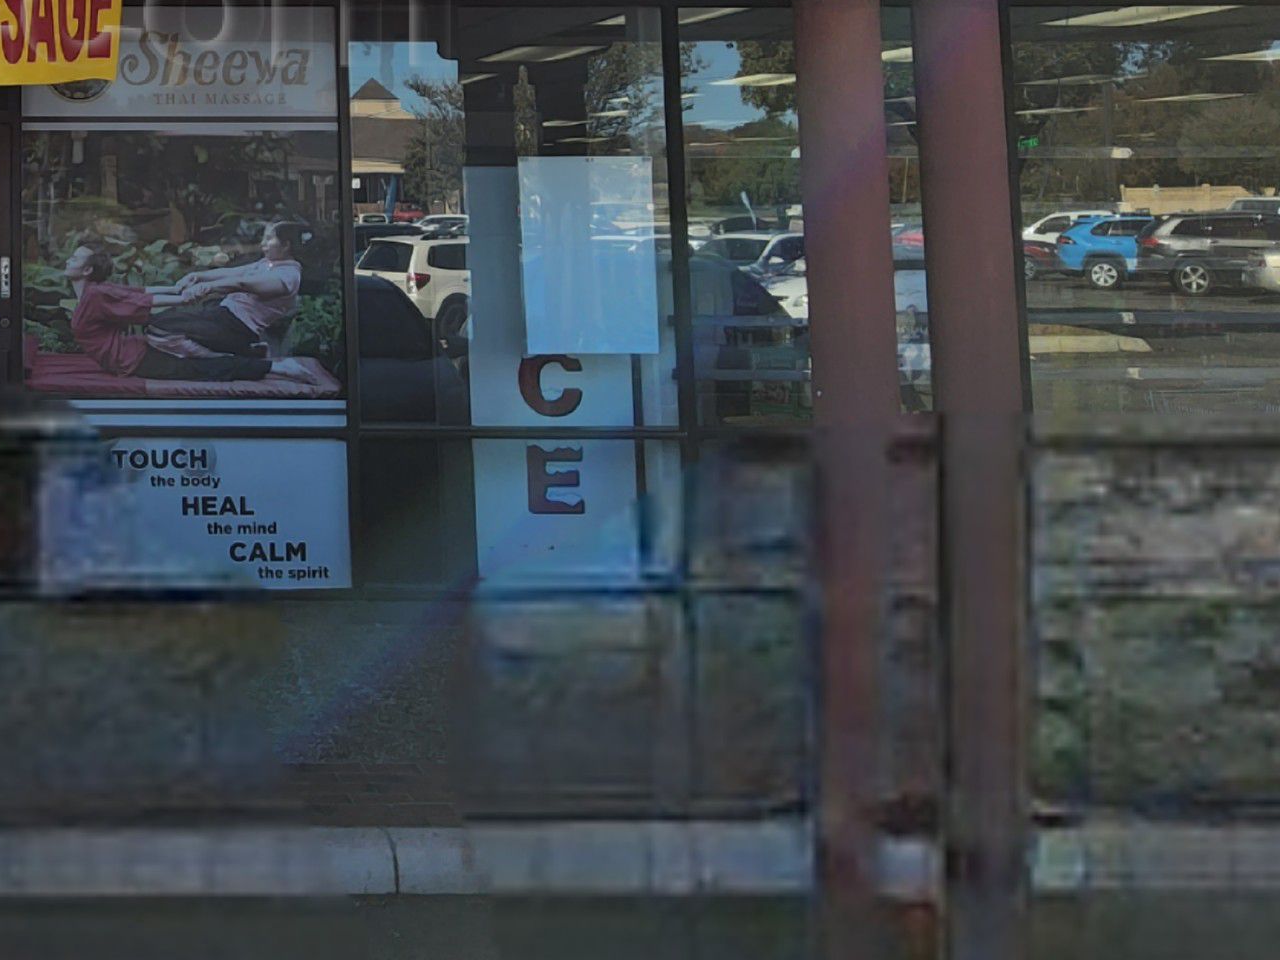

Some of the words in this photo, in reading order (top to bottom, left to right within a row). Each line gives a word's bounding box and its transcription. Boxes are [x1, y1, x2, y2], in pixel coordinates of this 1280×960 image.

[121, 30, 312, 87] Sheewa
[153, 93, 196, 105] THAI
[204, 92, 287, 105] MASSAGE
[111, 448, 208, 470] TOUCH
[150, 475, 175, 487] the
[180, 474, 221, 489] body
[181, 496, 254, 516] HEAL
[207, 522, 232, 534] the
[237, 522, 277, 534] mind
[229, 542, 307, 562] CALM
[258, 566, 283, 579] the
[287, 566, 330, 583] spirit
